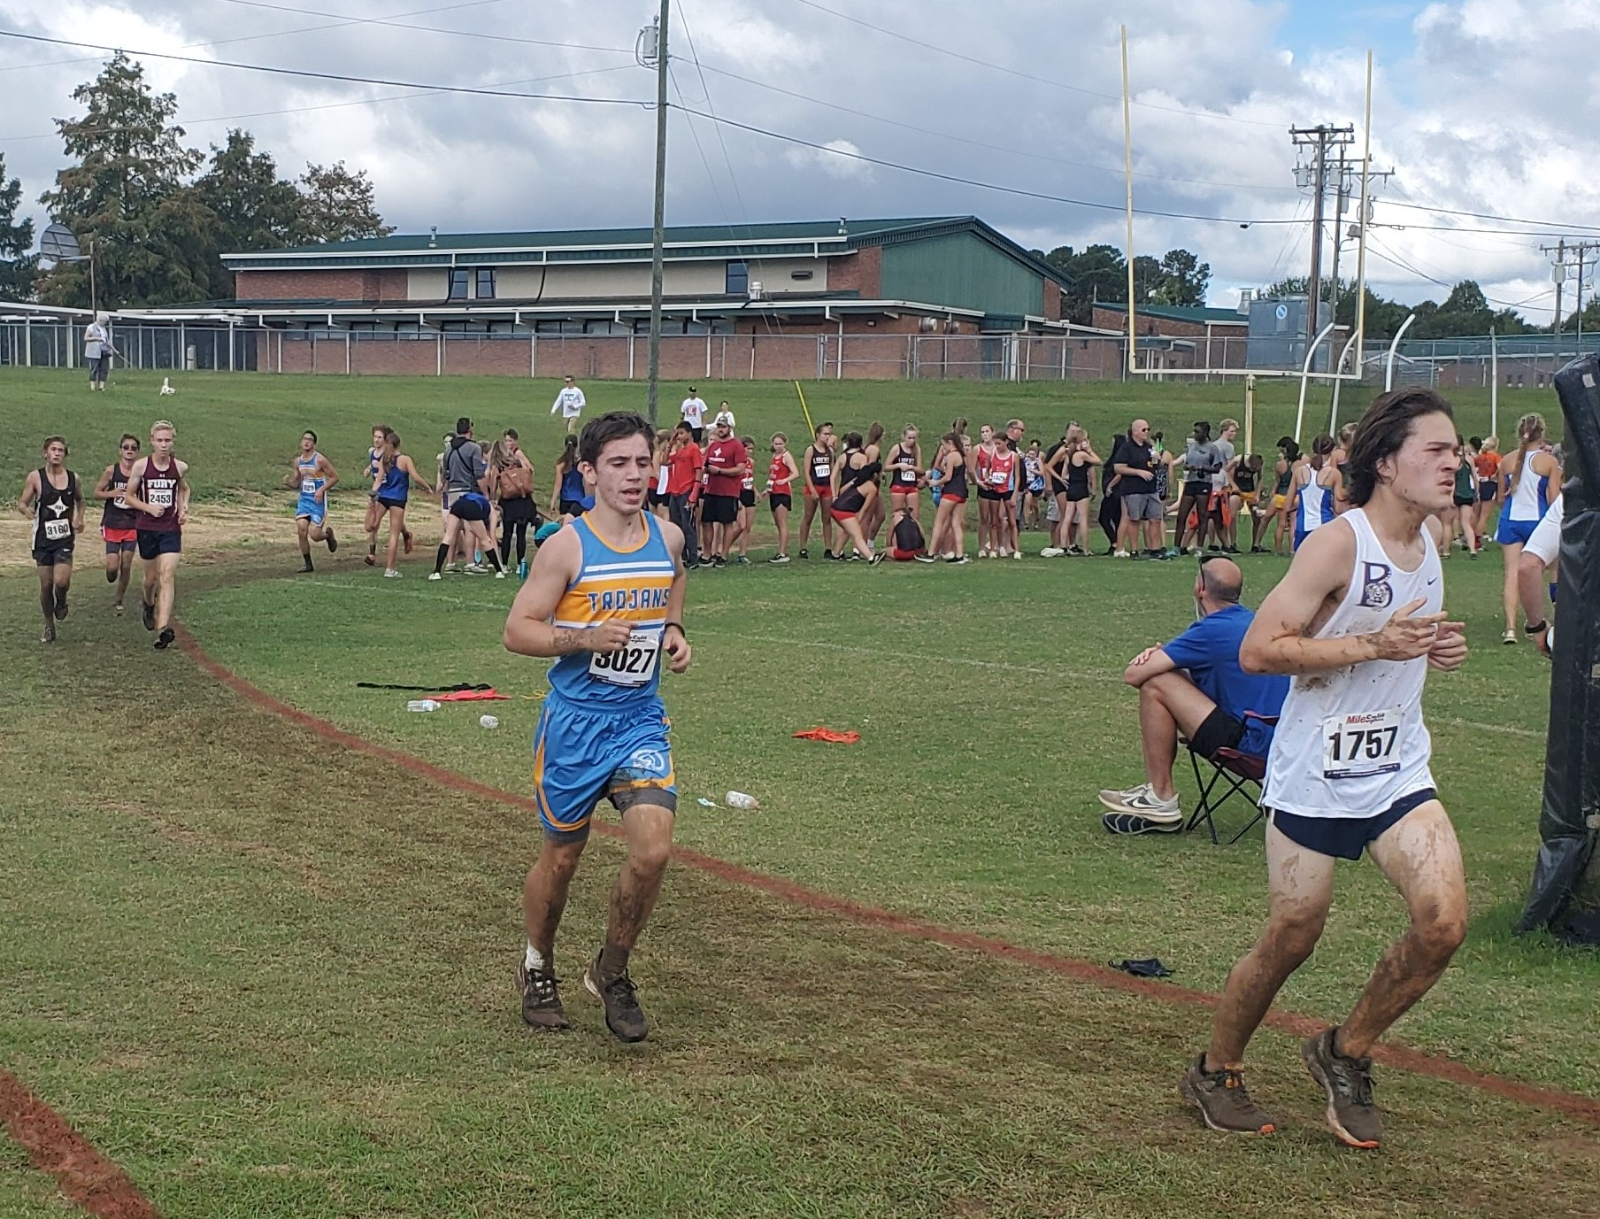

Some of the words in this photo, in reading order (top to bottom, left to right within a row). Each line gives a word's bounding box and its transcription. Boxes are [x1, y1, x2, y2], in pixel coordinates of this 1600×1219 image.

[147, 479, 176, 488] FURY
[150, 494, 170, 503] 2453
[587, 588, 670, 612] TROJANS
[595, 647, 656, 674] 3027
[1328, 725, 1399, 761] 1757
